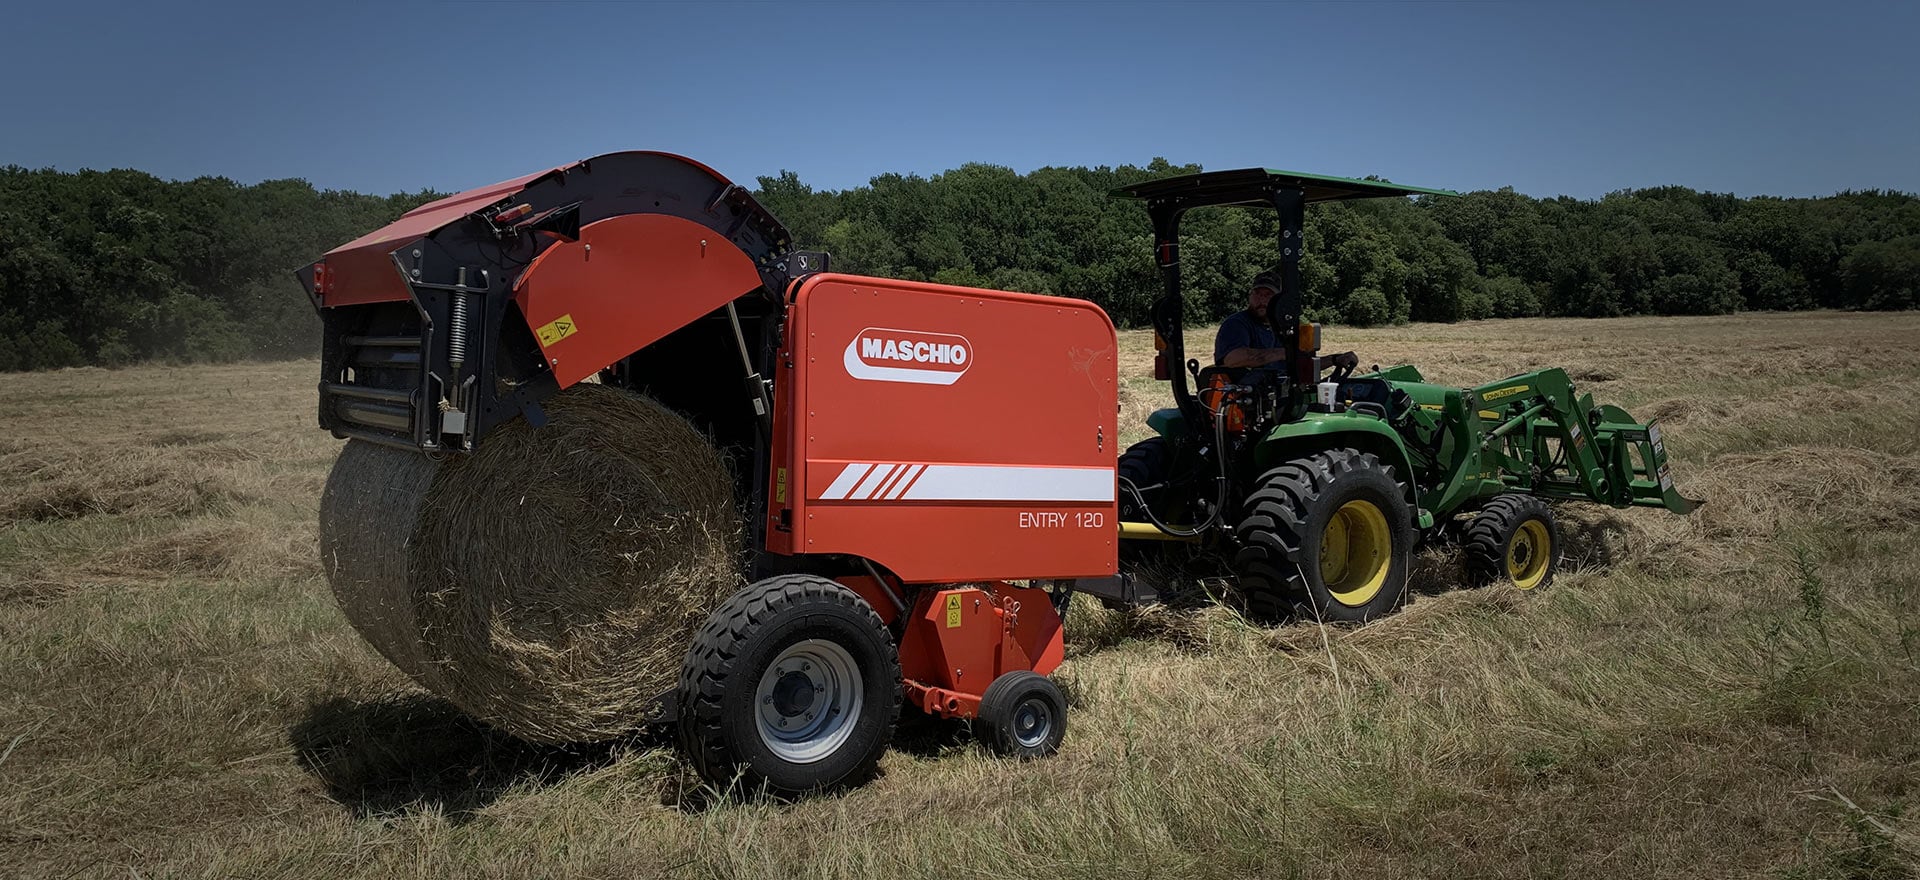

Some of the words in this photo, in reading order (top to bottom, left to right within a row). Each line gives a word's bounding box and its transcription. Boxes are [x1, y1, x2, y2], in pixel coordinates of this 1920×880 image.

[862, 337, 966, 365] MASCHIO
[1019, 512, 1068, 528] ENTRY
[1075, 512, 1104, 528] 120
